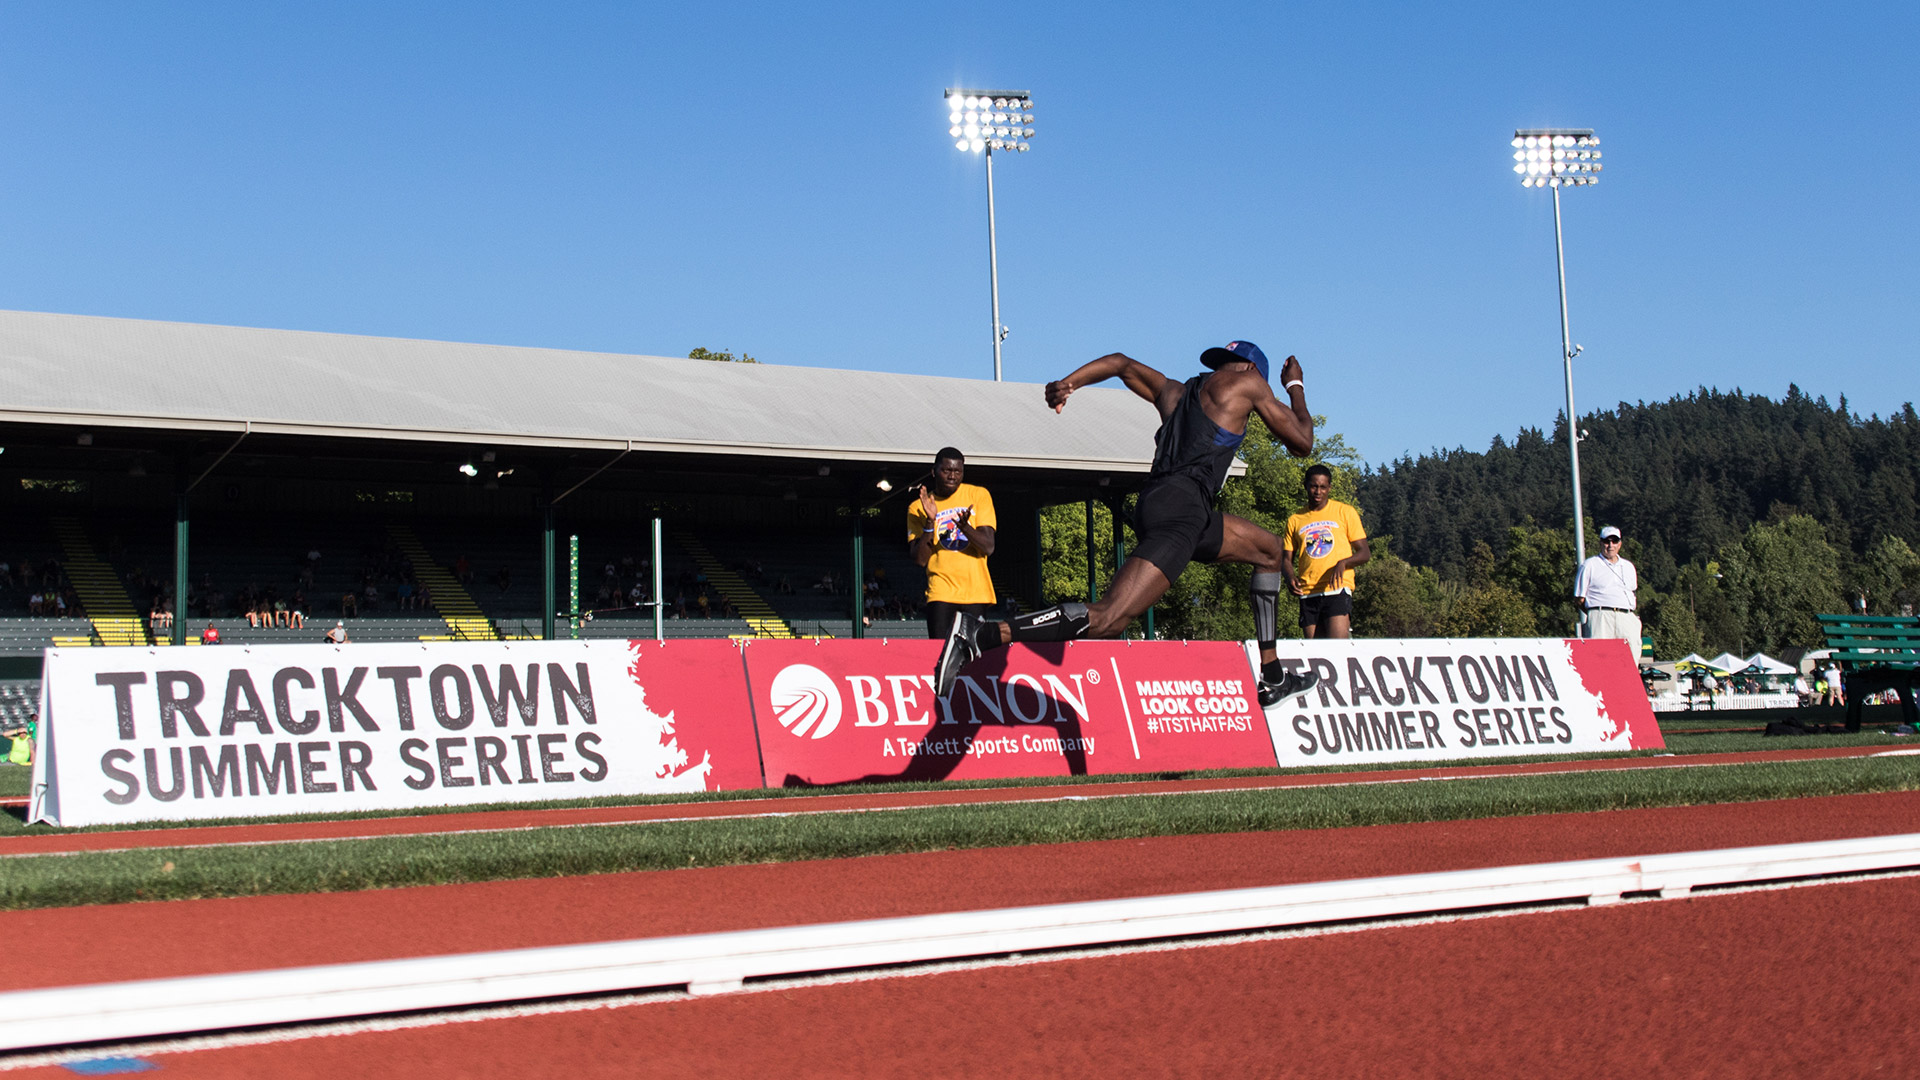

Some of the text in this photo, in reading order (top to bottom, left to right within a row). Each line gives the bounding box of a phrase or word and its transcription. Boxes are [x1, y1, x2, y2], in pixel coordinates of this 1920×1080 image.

[1136, 679, 1243, 697] MAKING FAST
[95, 662, 598, 741] TRACKTOWN
[1140, 696, 1249, 716] LOOK GOOD
[1147, 715, 1253, 734] #ITSTHATFAST
[1292, 706, 1573, 756] SUMMER SERIES
[883, 734, 1095, 759] A Tarkett Sports Company
[101, 732, 609, 805] SUMMER SERIES
